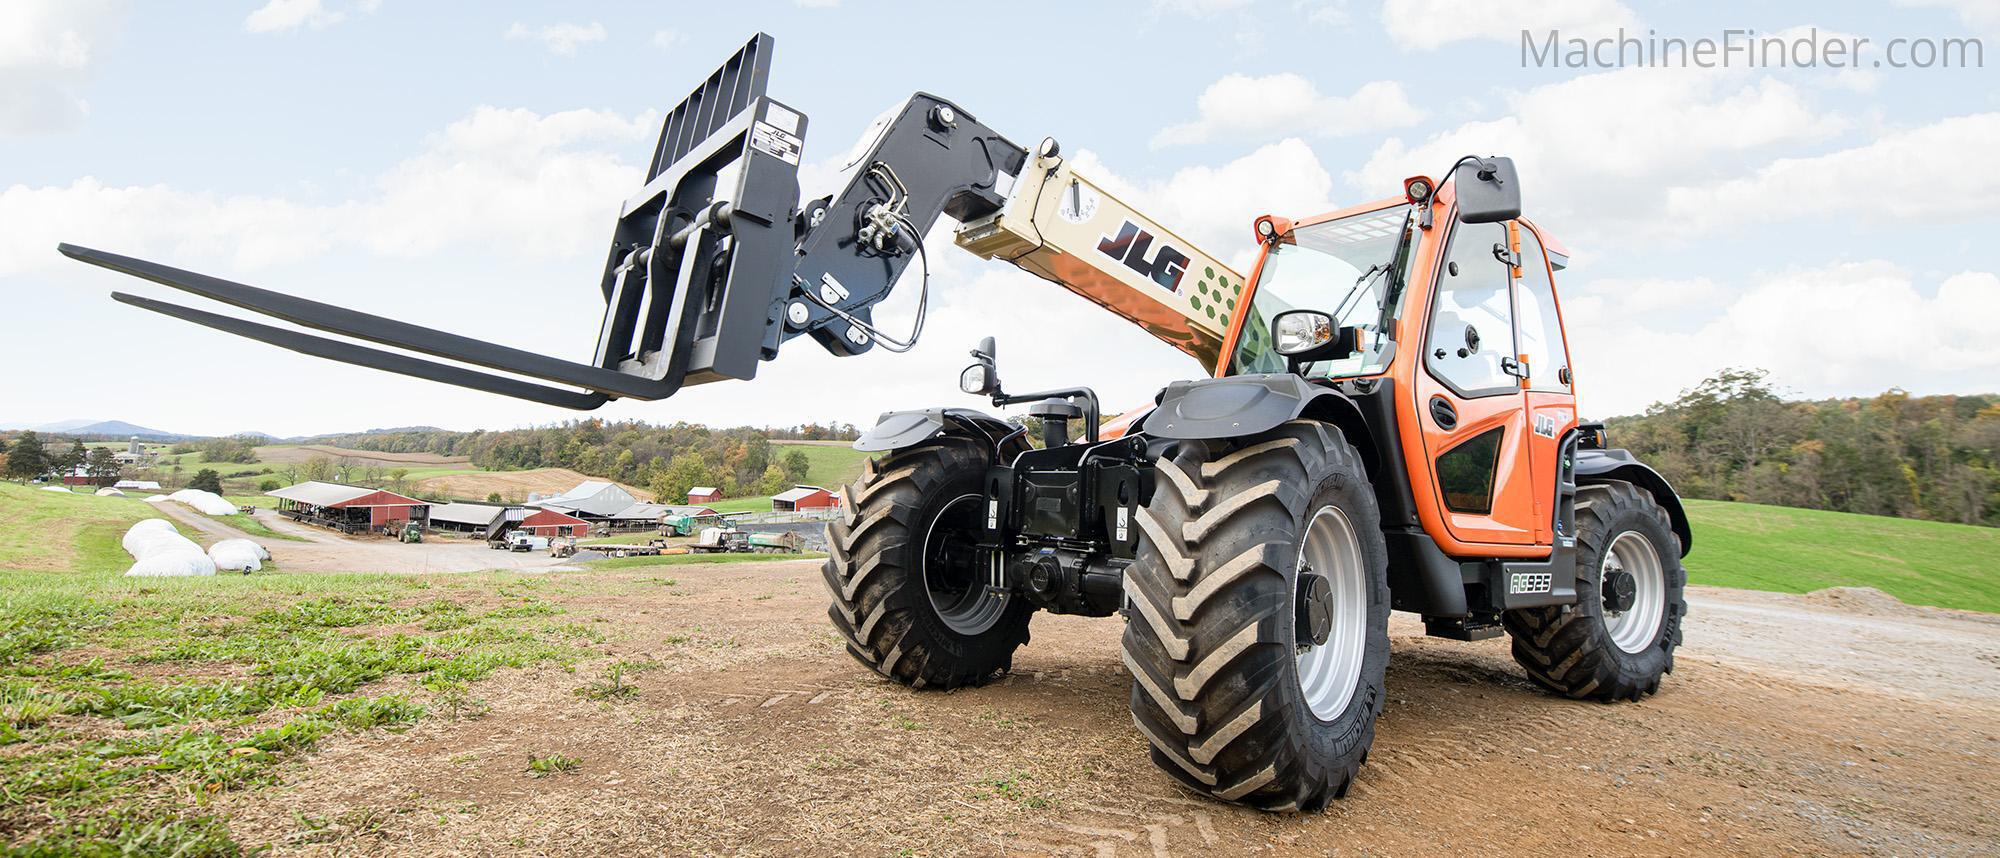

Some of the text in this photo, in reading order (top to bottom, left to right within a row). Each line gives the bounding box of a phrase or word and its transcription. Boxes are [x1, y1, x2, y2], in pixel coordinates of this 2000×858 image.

[770, 129, 786, 139] JLG
[1096, 219, 1191, 293] JLG
[1534, 414, 1554, 438] JLG
[1510, 573, 1552, 594] AG925
